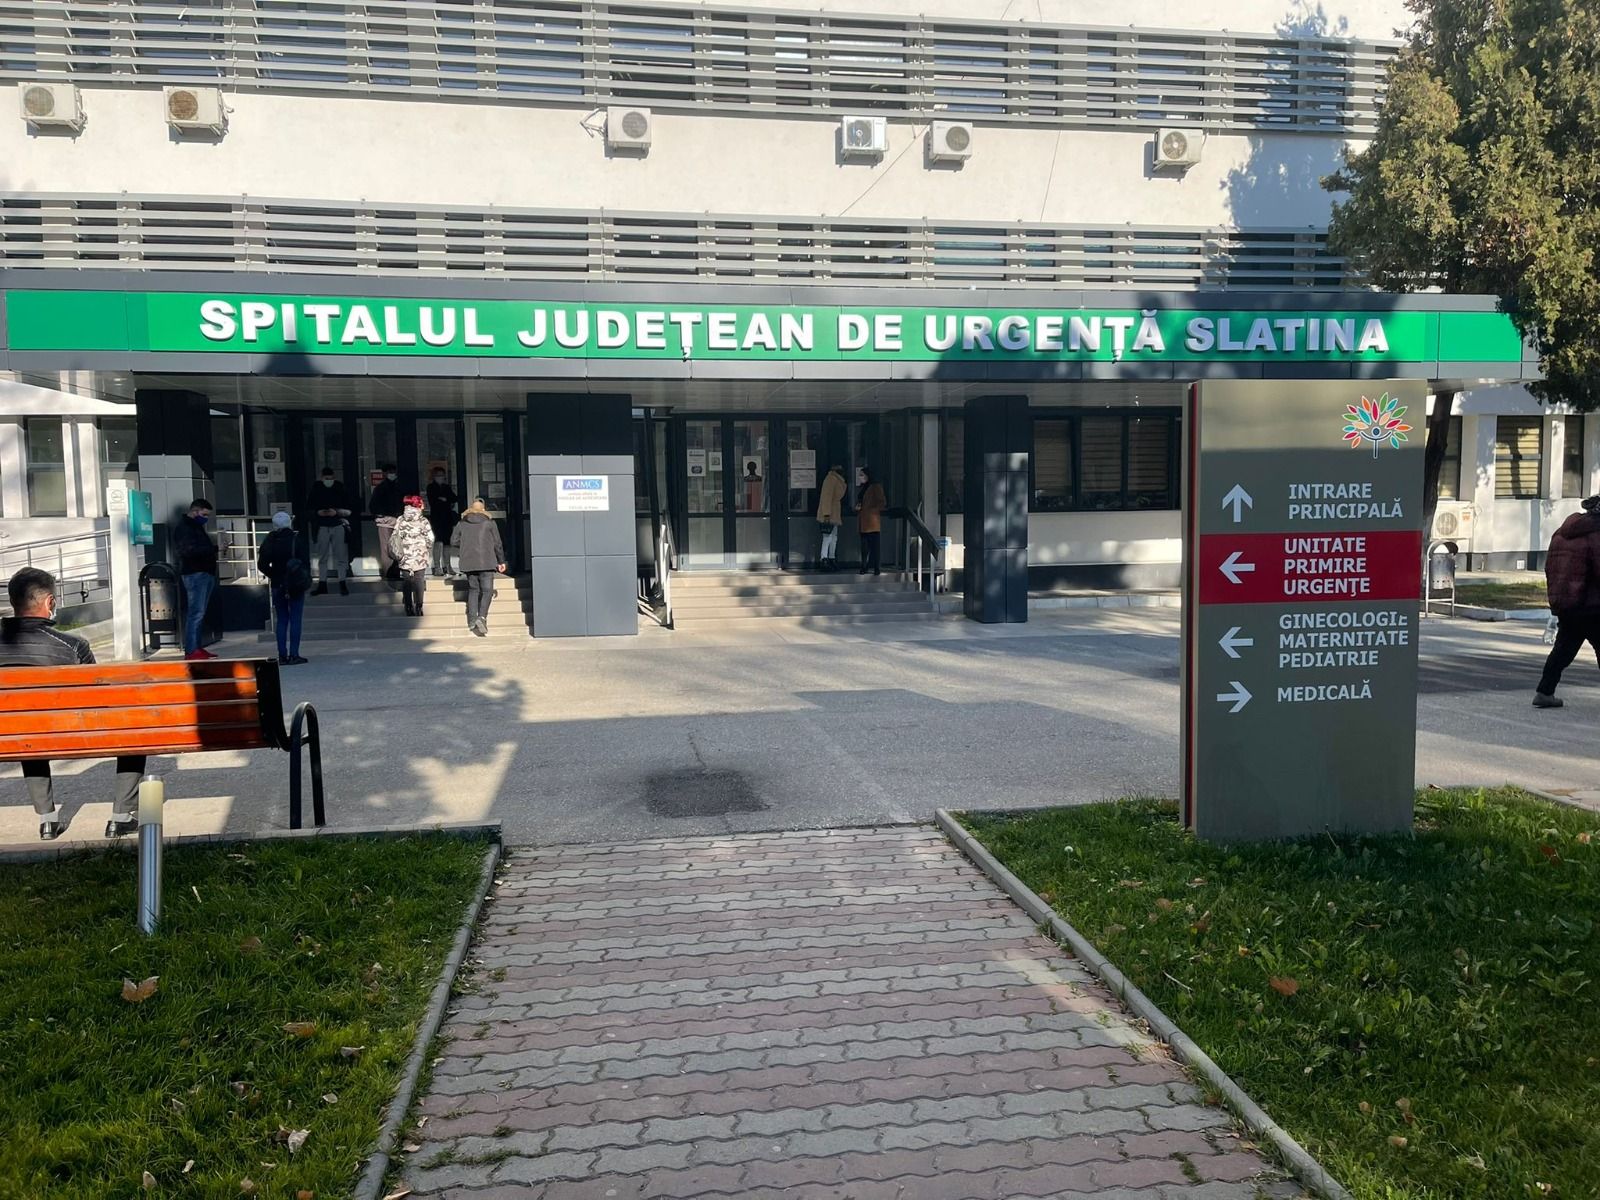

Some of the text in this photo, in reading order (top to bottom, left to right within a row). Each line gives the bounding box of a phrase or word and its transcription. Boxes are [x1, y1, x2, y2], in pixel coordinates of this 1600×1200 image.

[199, 299, 495, 347] SPITALUL
[837, 313, 903, 352] DE
[1184, 316, 1391, 353] SLATINA
[1288, 483, 1372, 499] INTRARE
[1288, 497, 1404, 520] PRINCIPALĂ
[1284, 536, 1367, 554] UNITATE
[1283, 557, 1367, 575] PRIMIRE
[1279, 611, 1408, 630] GINECOLOGIE
[1279, 630, 1409, 649] MATERNITATE
[1279, 650, 1379, 669] PEDIATRIE
[1277, 679, 1373, 703] MEDICALĂ
